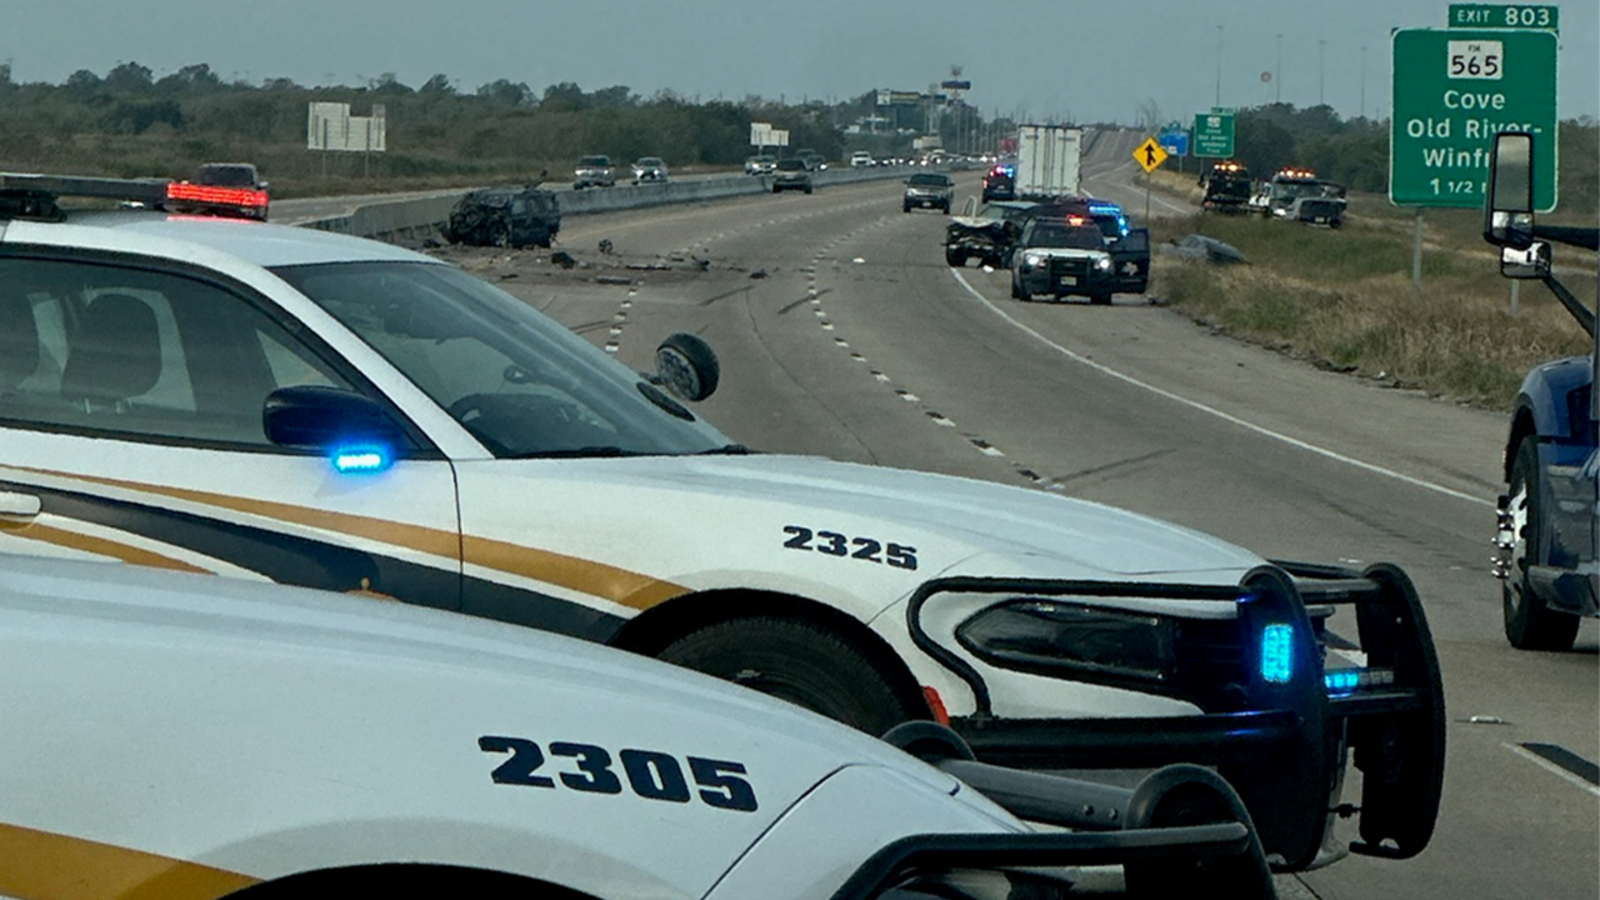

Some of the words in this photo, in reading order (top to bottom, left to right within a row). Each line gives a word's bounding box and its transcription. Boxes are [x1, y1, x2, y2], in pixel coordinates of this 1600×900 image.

[1457, 10, 1491, 22] EXIT
[1505, 8, 1550, 25] 803
[1452, 55, 1498, 76] 565
[1444, 90, 1506, 109] Cove
[1407, 118, 1450, 137] Old
[1430, 178, 1439, 195] 1
[1448, 181, 1473, 193] 1/2
[783, 525, 917, 571] 2325
[478, 735, 758, 812] 2305
